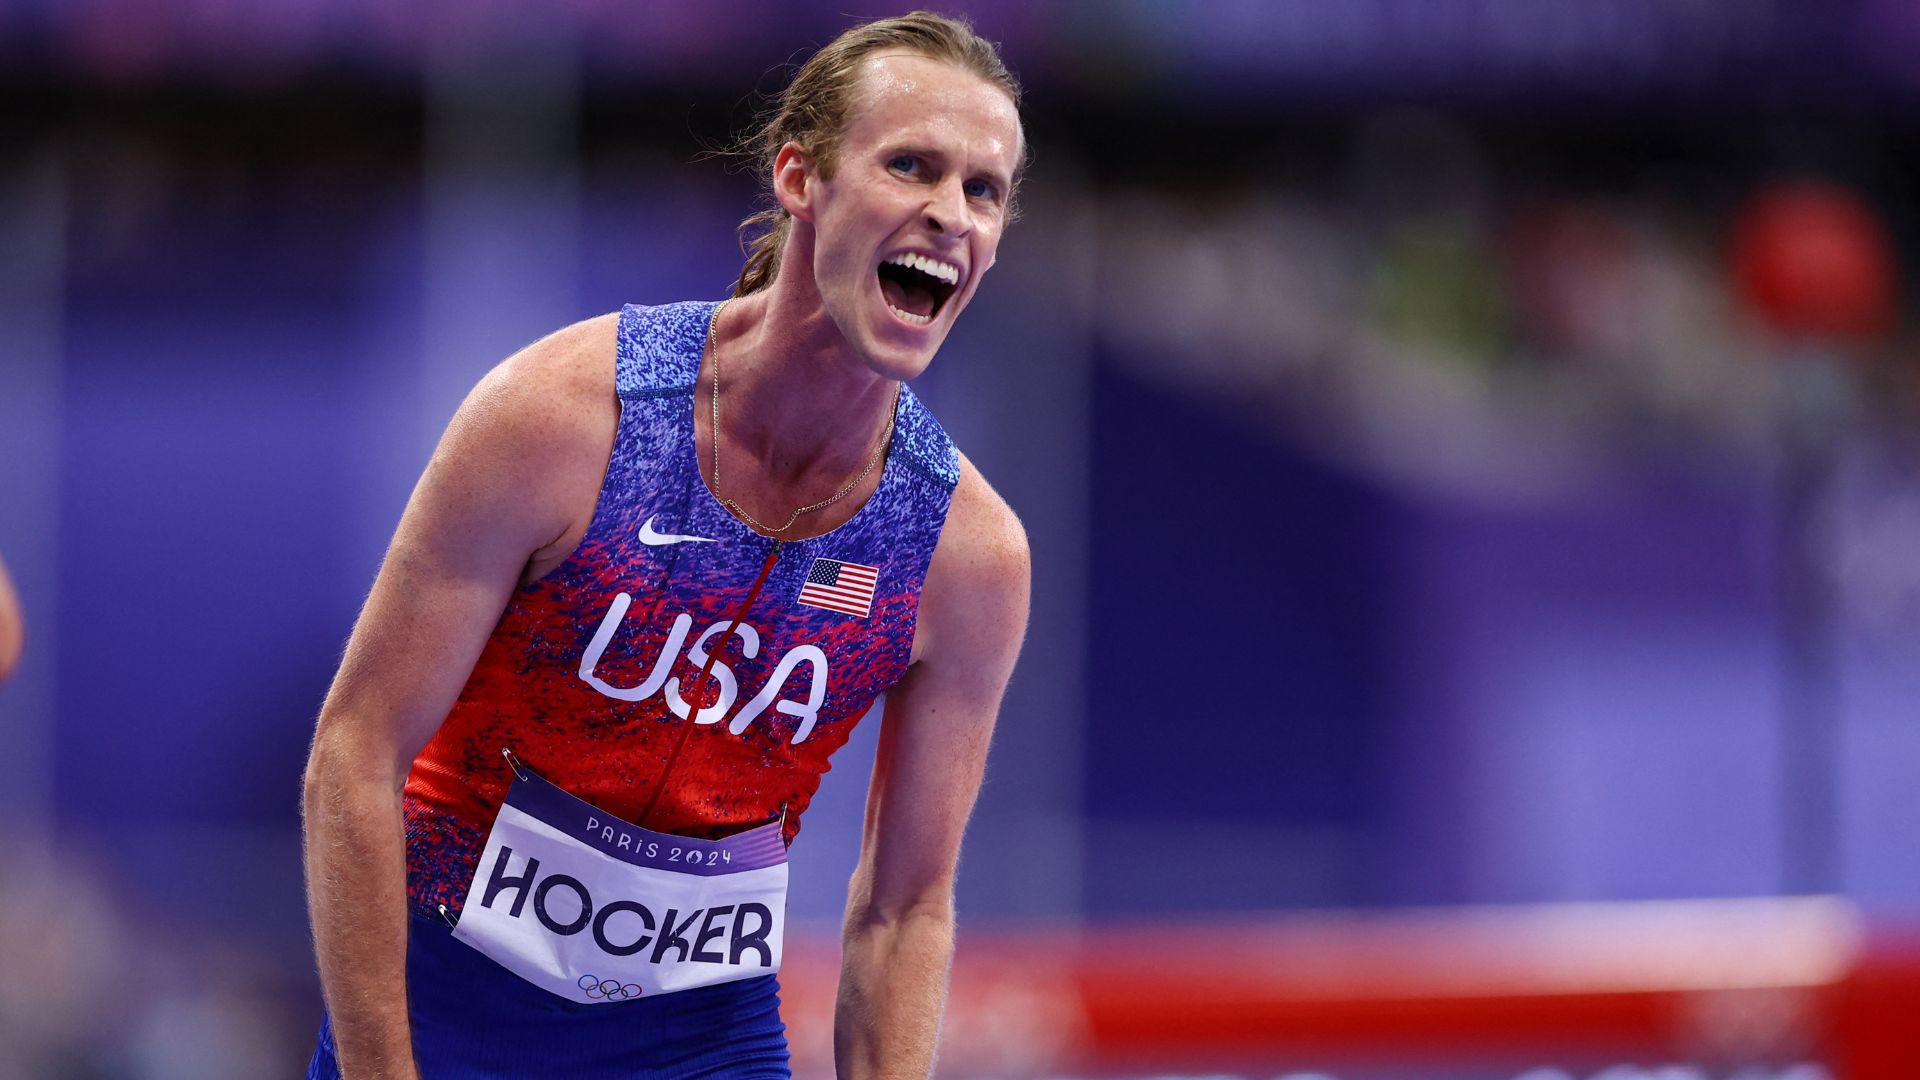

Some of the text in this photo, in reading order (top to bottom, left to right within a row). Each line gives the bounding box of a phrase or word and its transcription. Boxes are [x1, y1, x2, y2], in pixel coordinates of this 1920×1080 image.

[578, 592, 828, 745] USA
[480, 845, 773, 968] HOCKER
[667, 847, 732, 866] 2024
